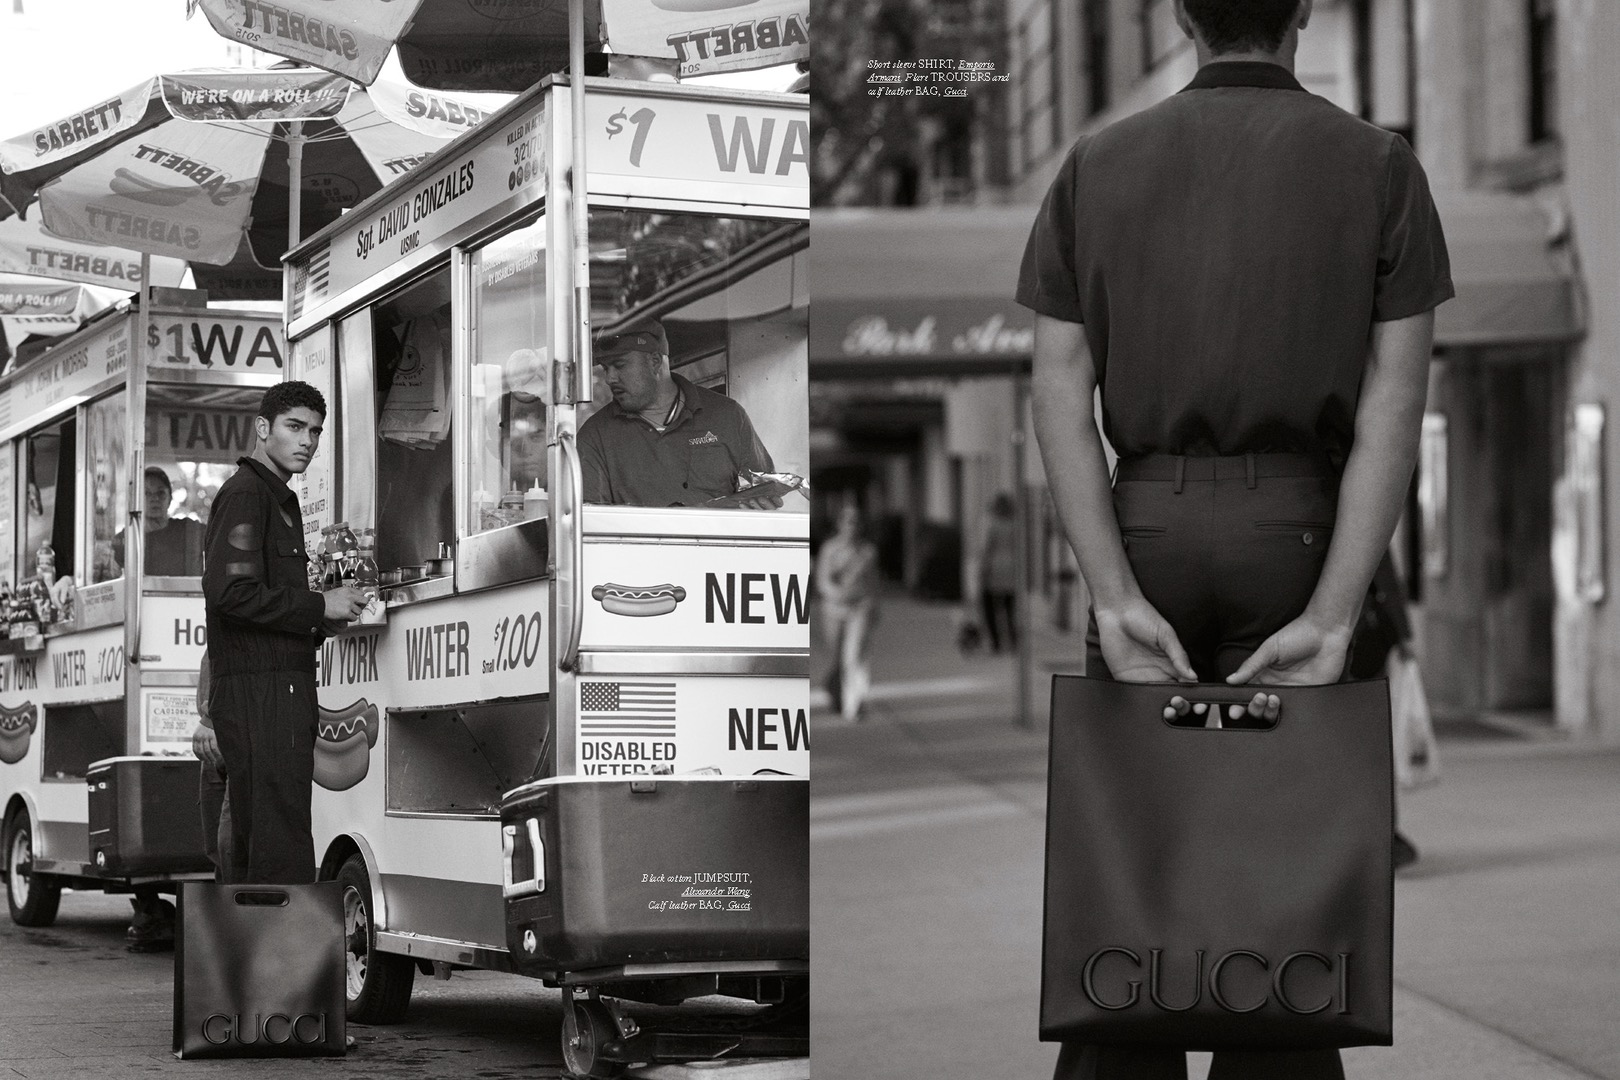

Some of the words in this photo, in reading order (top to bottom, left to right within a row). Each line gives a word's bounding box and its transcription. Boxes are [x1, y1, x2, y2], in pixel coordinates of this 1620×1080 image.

[181, 89, 228, 105] WE'RE
[232, 89, 255, 105] ON
[258, 89, 270, 103] A
[273, 89, 311, 103] ROLL
[315, 88, 335, 101] !!!
[33, 95, 123, 157] SABRETT
[507, 125, 524, 147] KILLED
[525, 120, 530, 135] IN
[606, 107, 656, 168] $1
[357, 225, 375, 260] Sgt.
[379, 201, 410, 244] DAVID
[413, 160, 474, 223] GONZALES
[400, 230, 420, 255] USMC
[26, 295, 51, 306] ROLL
[305, 347, 326, 372] MENU
[705, 573, 810, 624] NEW
[174, 618, 208, 646] Ho
[494, 611, 541, 672] $1.00
[53, 649, 87, 688] WATER
[338, 633, 379, 685] YORK
[406, 621, 470, 681] WATER
[13, 657, 38, 691] YORK
[581, 741, 677, 761] DISABLED
[1081, 946, 1353, 1016] GUCCI
[202, 1012, 328, 1045] GUCCI
